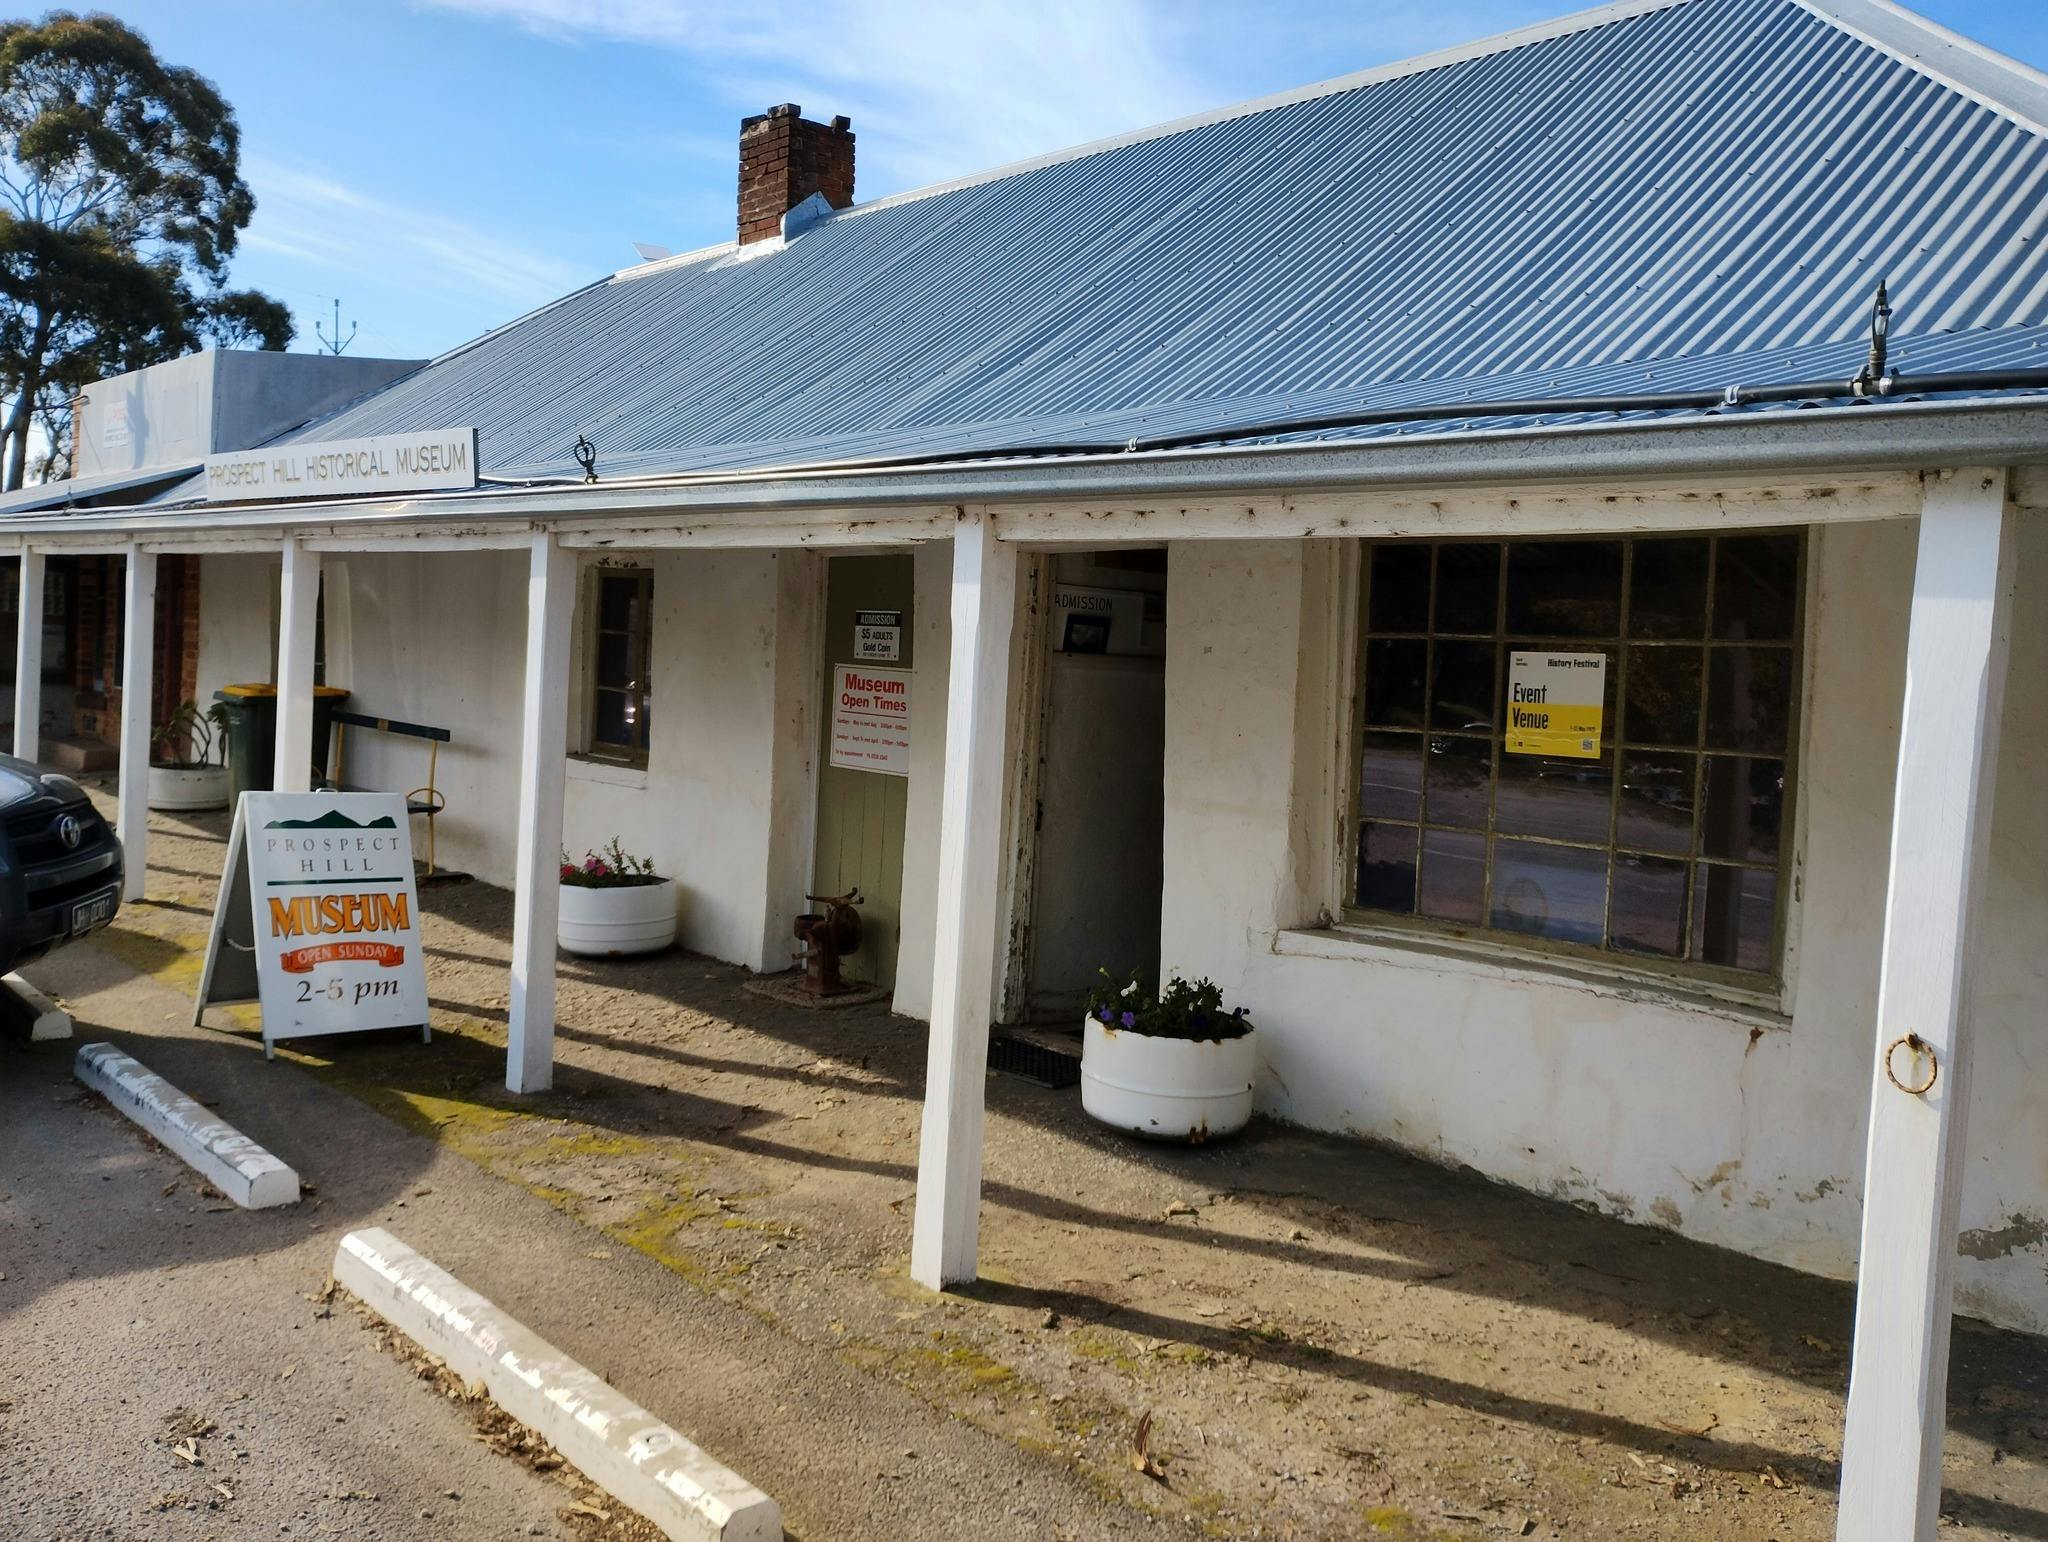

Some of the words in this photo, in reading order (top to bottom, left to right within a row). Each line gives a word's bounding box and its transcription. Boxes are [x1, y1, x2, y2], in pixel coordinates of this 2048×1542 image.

[208, 461, 266, 488] PROSPECT
[272, 458, 300, 483] HILL
[306, 450, 389, 481] HISTORICAL
[395, 443, 466, 474] MUSEUM
[1055, 594, 1113, 612] ADMISSION
[860, 614, 896, 625] ADMISSION
[872, 631, 894, 641] ADULTS
[863, 642, 876, 652] Gold
[877, 643, 891, 653] Coin
[1547, 659, 1572, 669] History
[1573, 659, 1600, 669] Festival
[845, 673, 905, 695] Museum
[1513, 682, 1548, 704] Event
[841, 693, 869, 710] Open
[873, 696, 907, 712] Times
[1512, 707, 1549, 730] Venue
[267, 837, 401, 853] PROSPECT
[301, 858, 374, 873] HILL
[267, 892, 411, 940] MUSEUM
[298, 946, 332, 964] OPEN
[337, 944, 389, 958] SUNDAY
[296, 978, 344, 1003] 2-5
[354, 979, 400, 1005] pm
